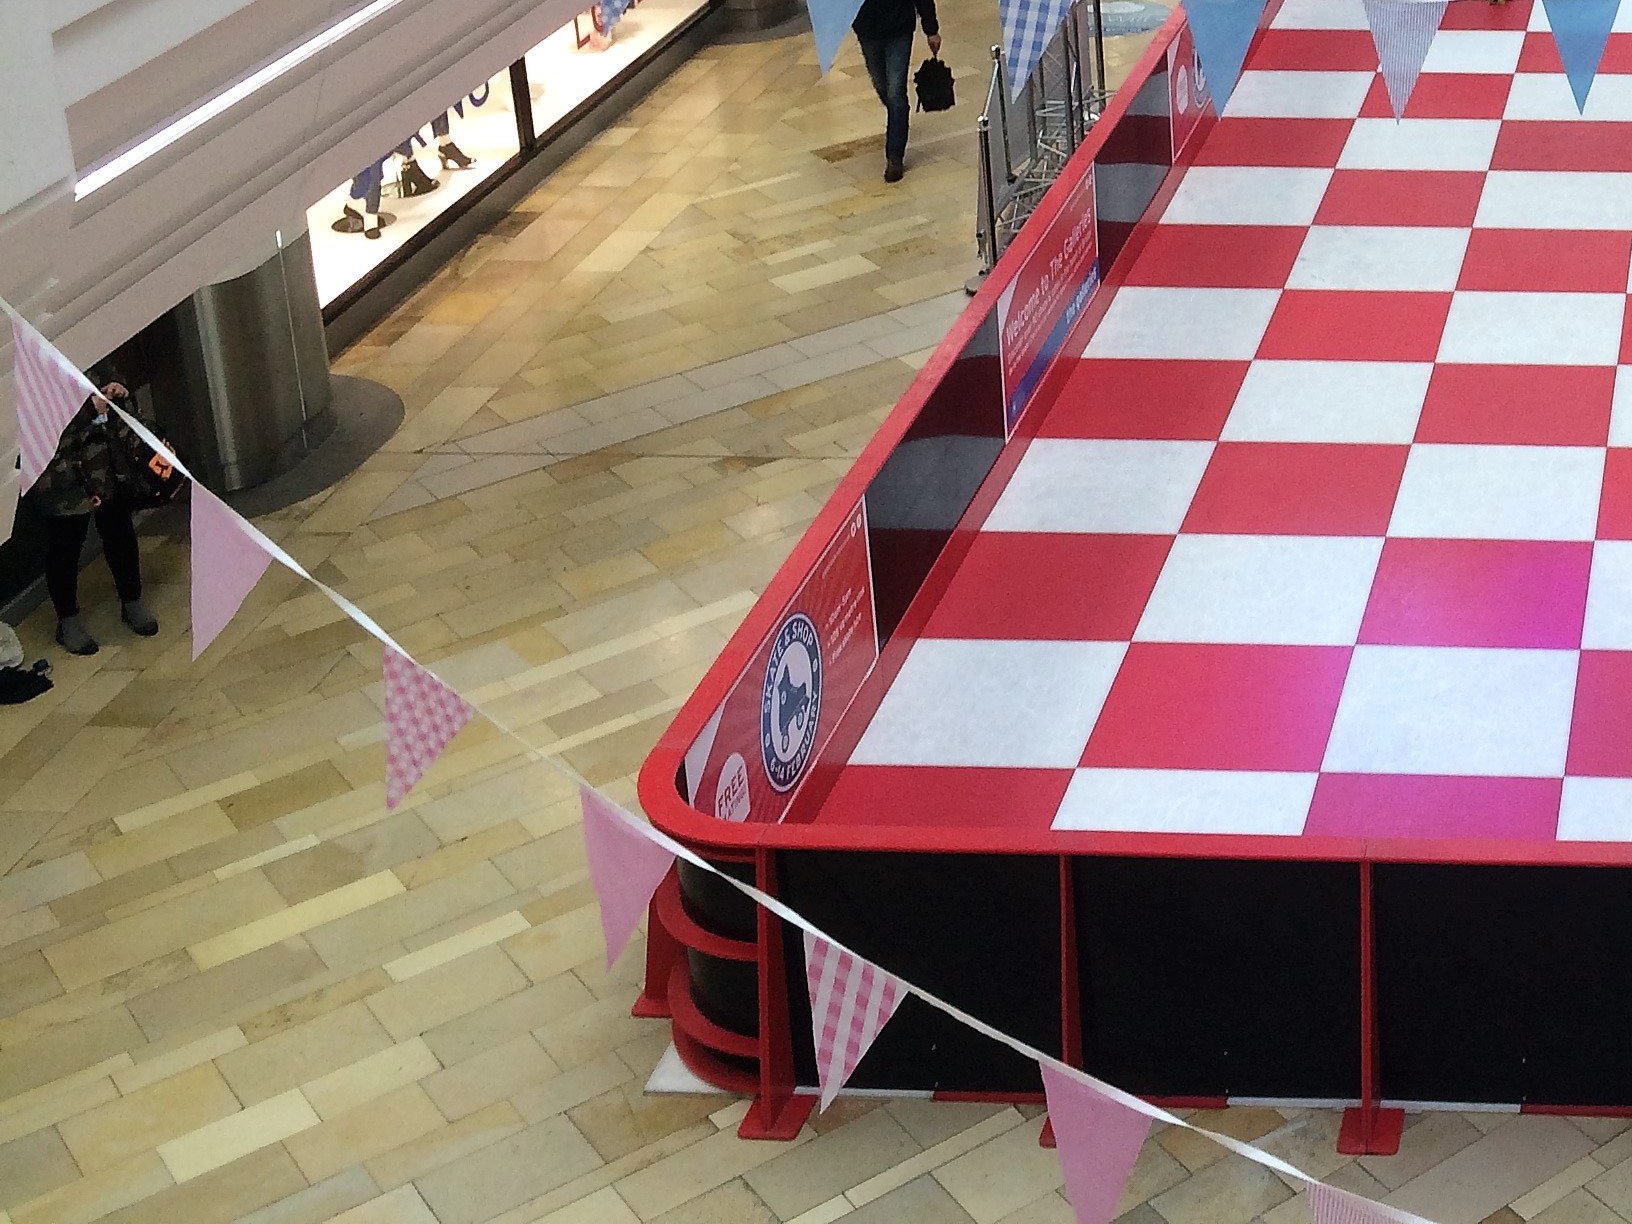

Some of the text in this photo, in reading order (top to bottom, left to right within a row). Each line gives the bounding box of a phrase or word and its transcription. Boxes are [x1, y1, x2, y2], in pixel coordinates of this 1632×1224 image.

[1006, 287, 1040, 346] Welcome
[1040, 272, 1049, 296] to
[1050, 248, 1063, 280] The
[1063, 207, 1092, 260] Galleries
[764, 621, 814, 714] SKATE & SHOP
[785, 690, 819, 780] FEBRUARY
[717, 765, 743, 817] FREE
